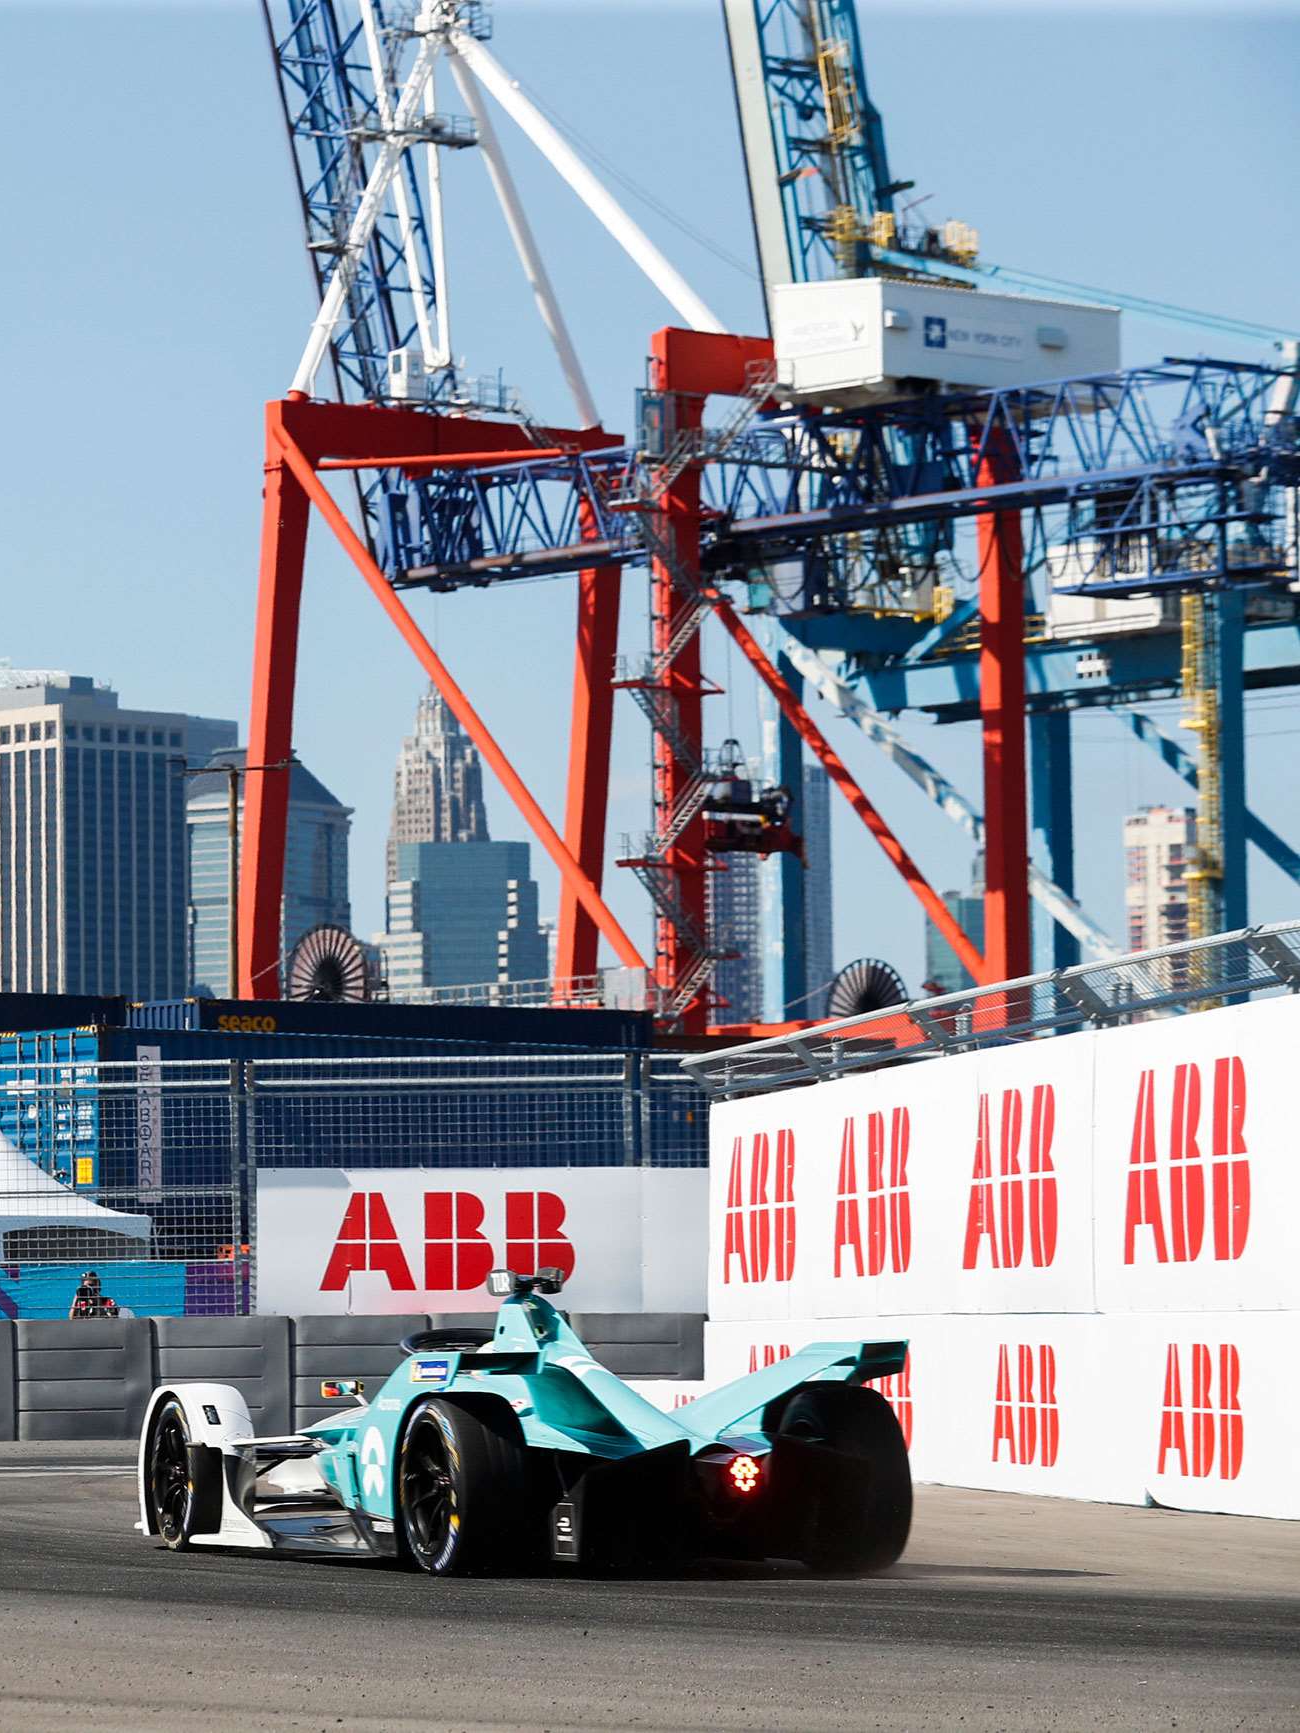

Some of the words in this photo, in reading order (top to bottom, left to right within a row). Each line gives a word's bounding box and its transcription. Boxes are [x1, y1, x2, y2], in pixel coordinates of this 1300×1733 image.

[218, 1014, 277, 1031] seaco
[724, 1129, 796, 1284] ABB
[834, 1107, 911, 1278] ABB
[962, 1084, 1058, 1270] ABB
[1124, 1056, 1250, 1265] ABB
[319, 1191, 576, 1291] ABB
[992, 1344, 1059, 1467] ABB
[1157, 1343, 1244, 1481] ABB
